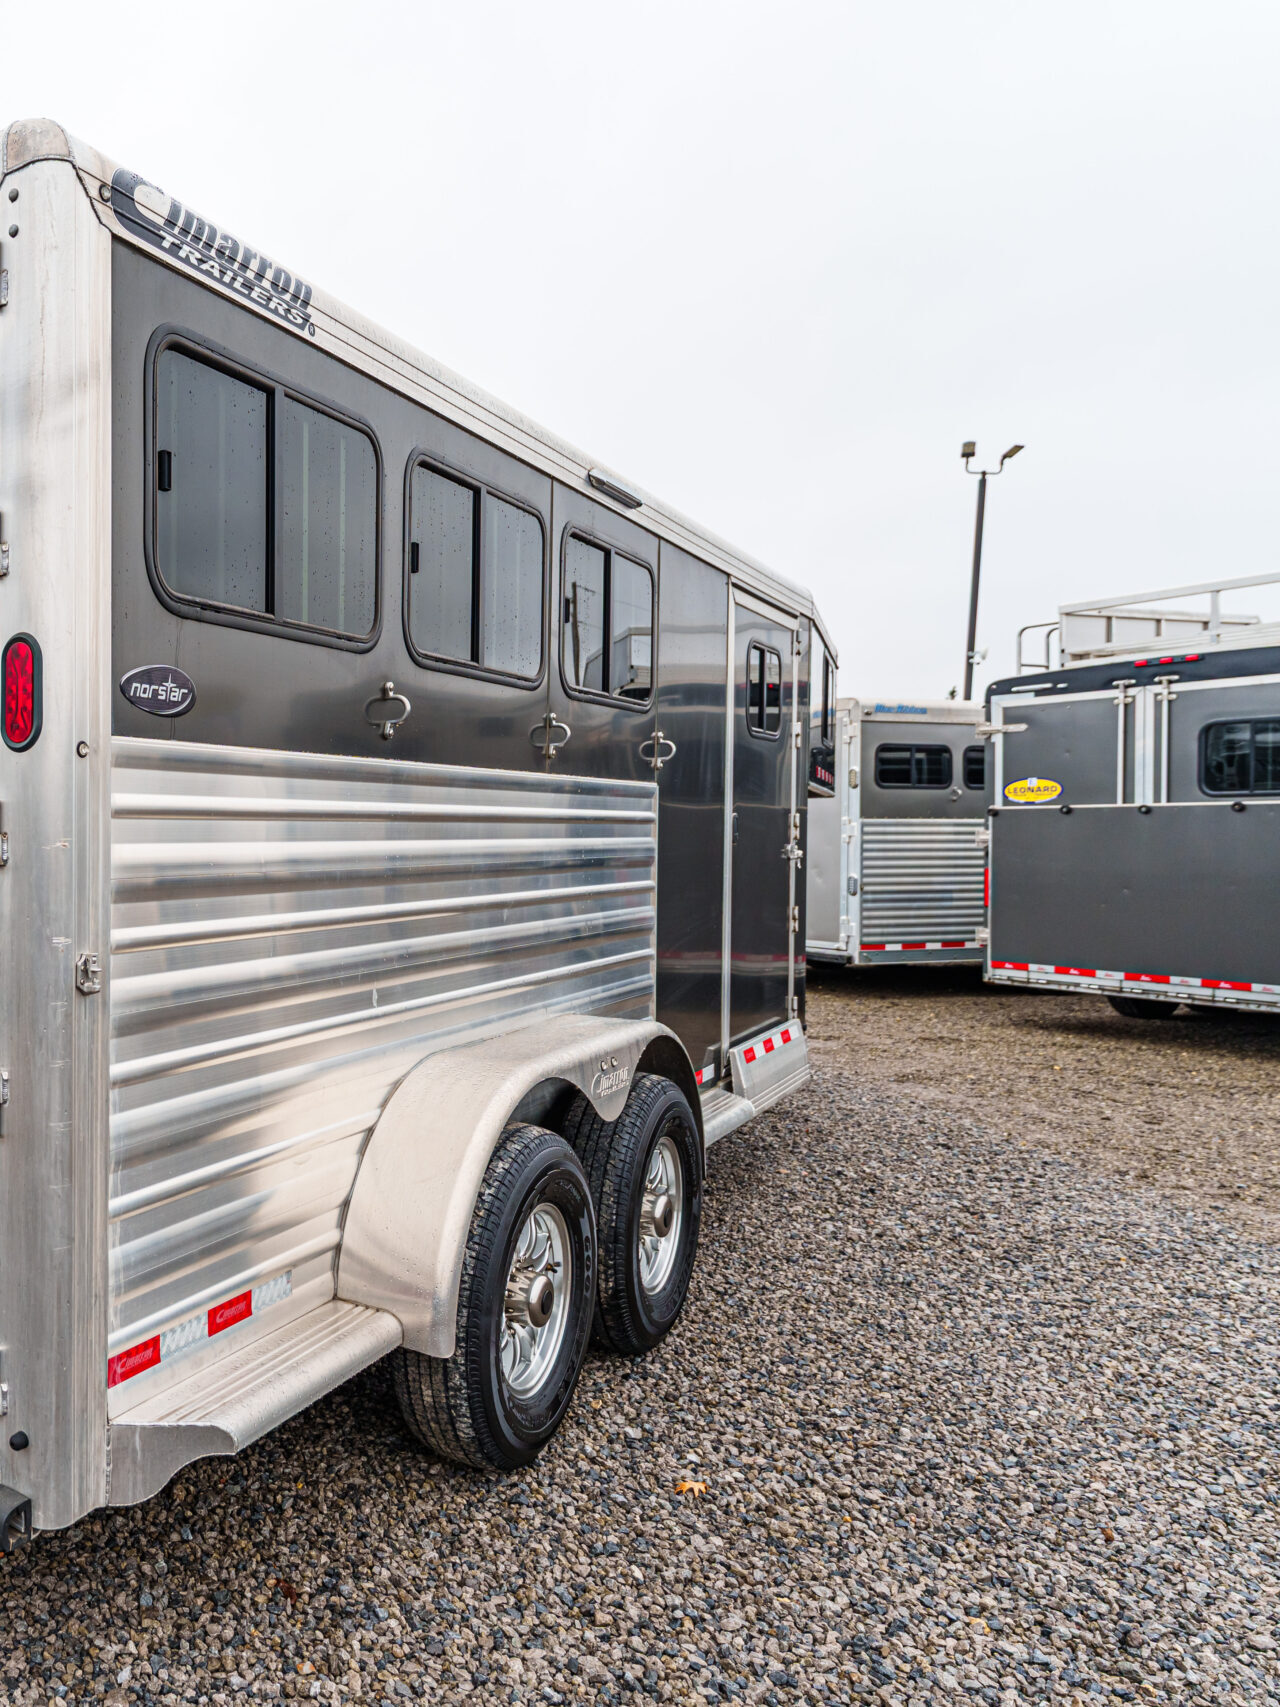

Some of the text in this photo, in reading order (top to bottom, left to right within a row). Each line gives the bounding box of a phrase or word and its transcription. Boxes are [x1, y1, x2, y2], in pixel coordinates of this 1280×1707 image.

[111, 168, 313, 311] Cimarron
[158, 230, 306, 326] TRAILERS
[130, 673, 188, 702] norstar
[1007, 786, 1058, 794] LEONARD
